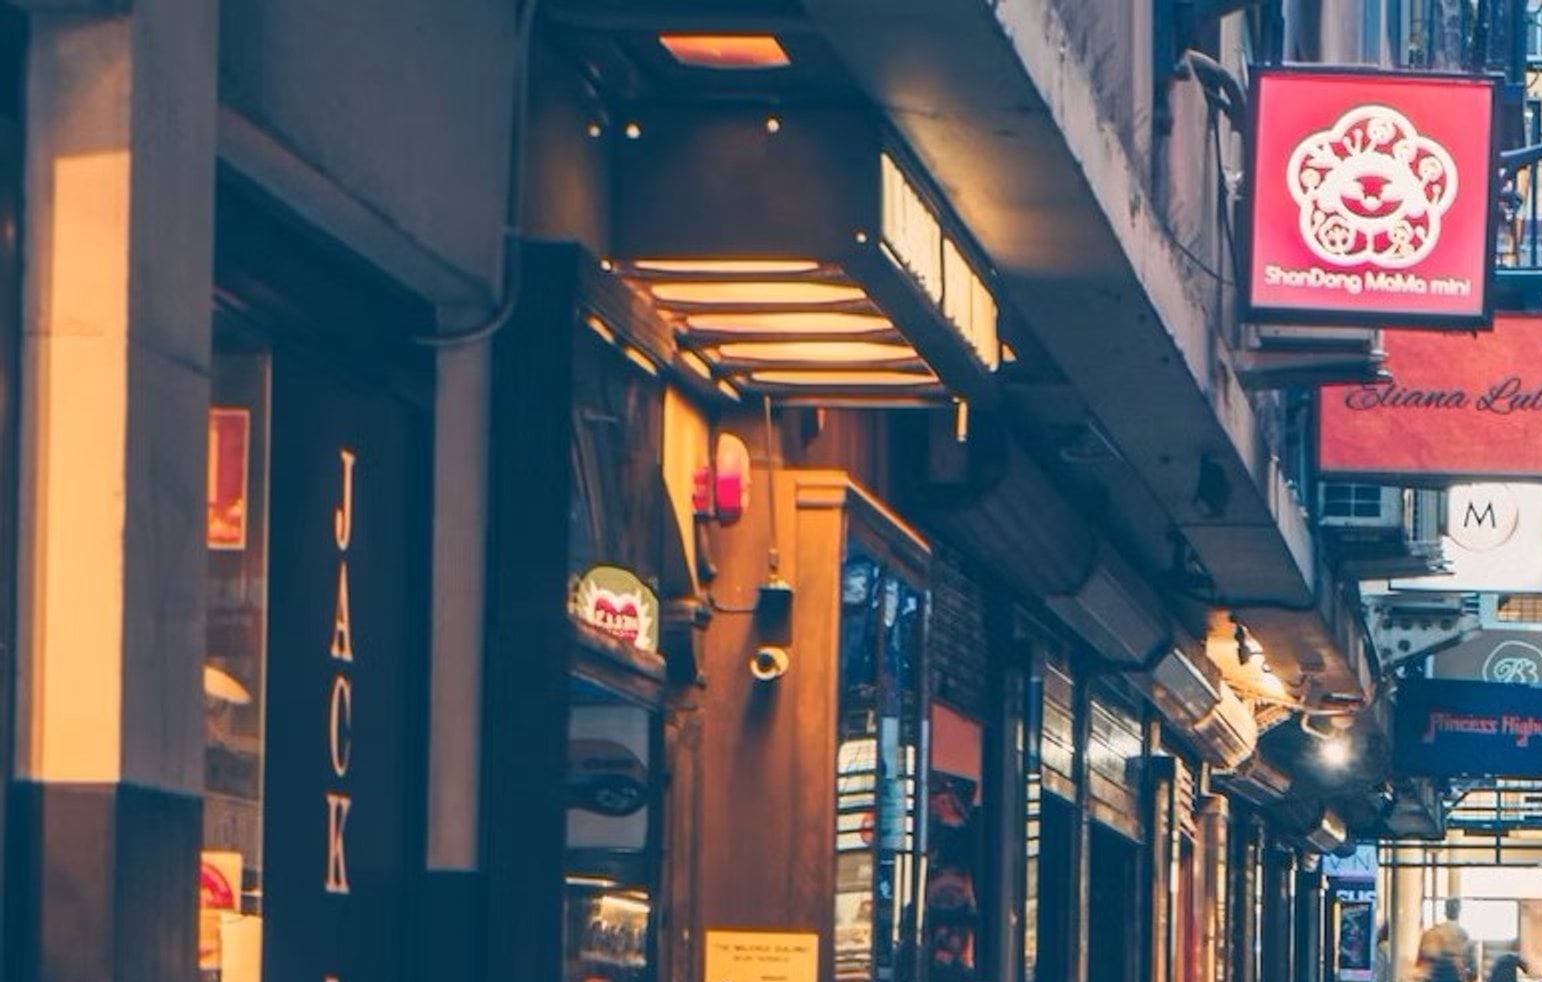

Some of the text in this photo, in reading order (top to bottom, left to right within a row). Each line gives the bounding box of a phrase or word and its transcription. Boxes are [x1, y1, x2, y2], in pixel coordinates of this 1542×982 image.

[1264, 265, 1472, 296] ShanDong MaMa mini
[1345, 380, 1467, 411] Eliana
[1463, 501, 1497, 528] M
[324, 448, 356, 894] JACK
[1423, 713, 1497, 744] Princess
